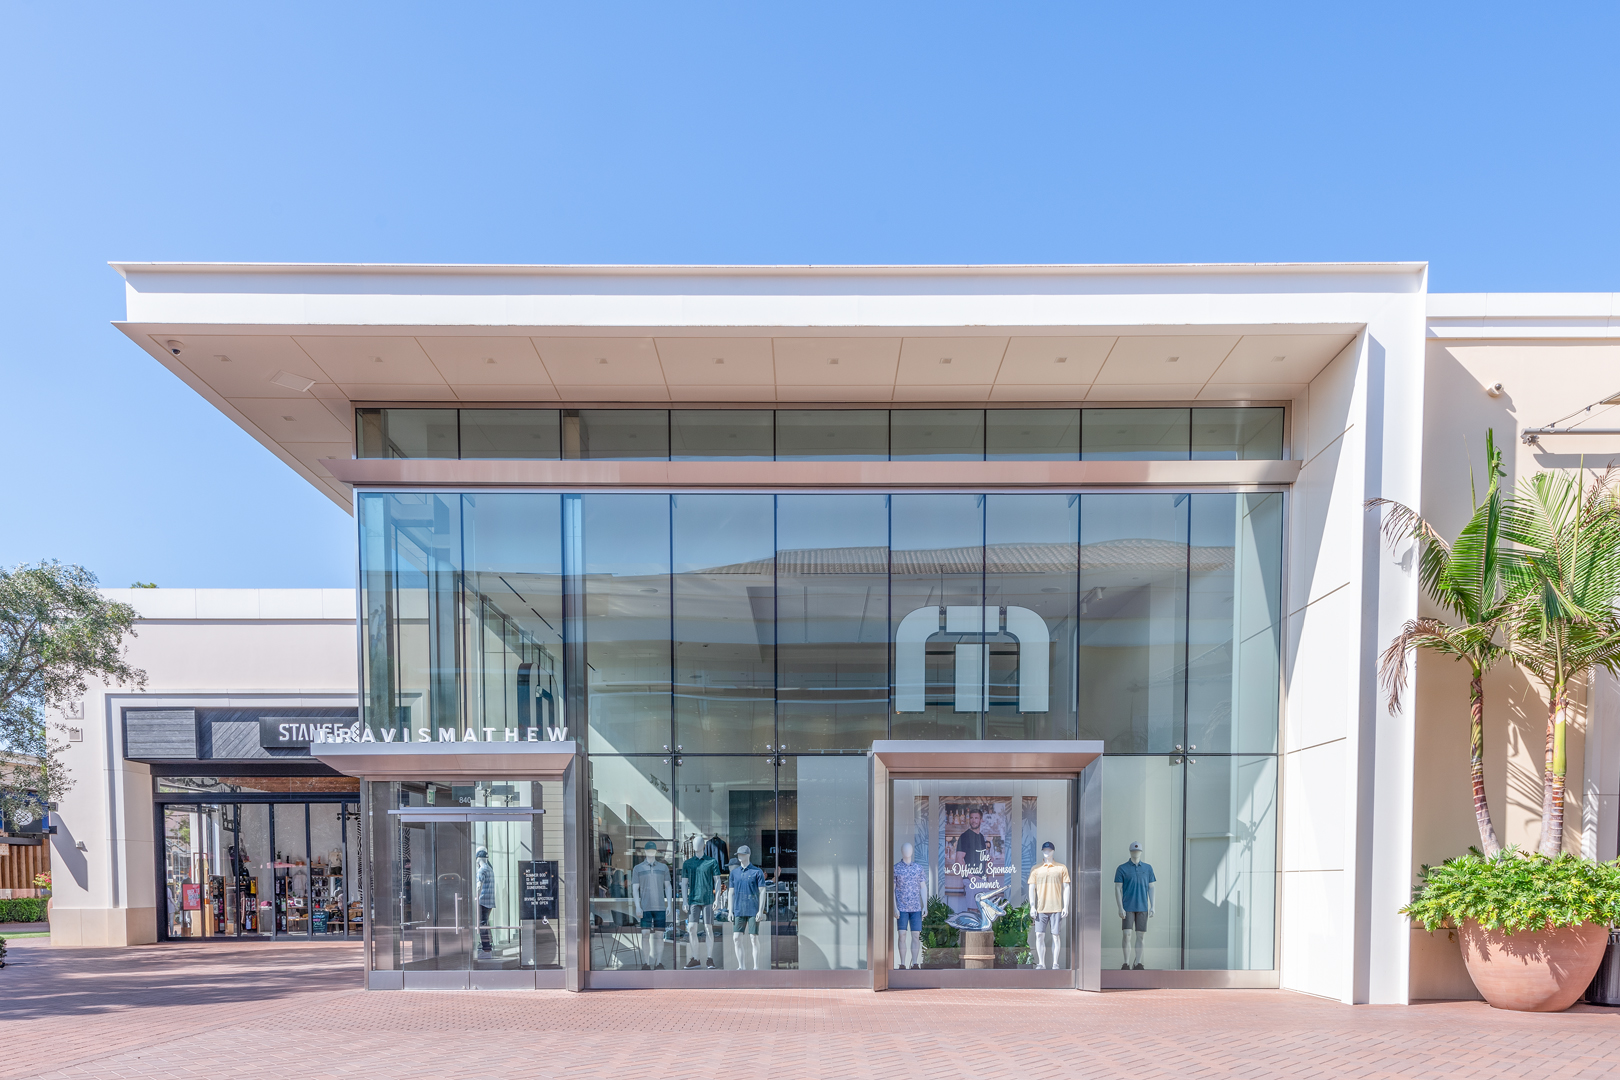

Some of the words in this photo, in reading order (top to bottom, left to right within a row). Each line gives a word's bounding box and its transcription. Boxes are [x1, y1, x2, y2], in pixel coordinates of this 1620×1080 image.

[314, 726, 568, 742] TRAVISMATHEW
[459, 796, 472, 804] 840
[976, 849, 991, 861] The
[986, 862, 1017, 878] Sponsor
[969, 877, 1000, 889] Summer
